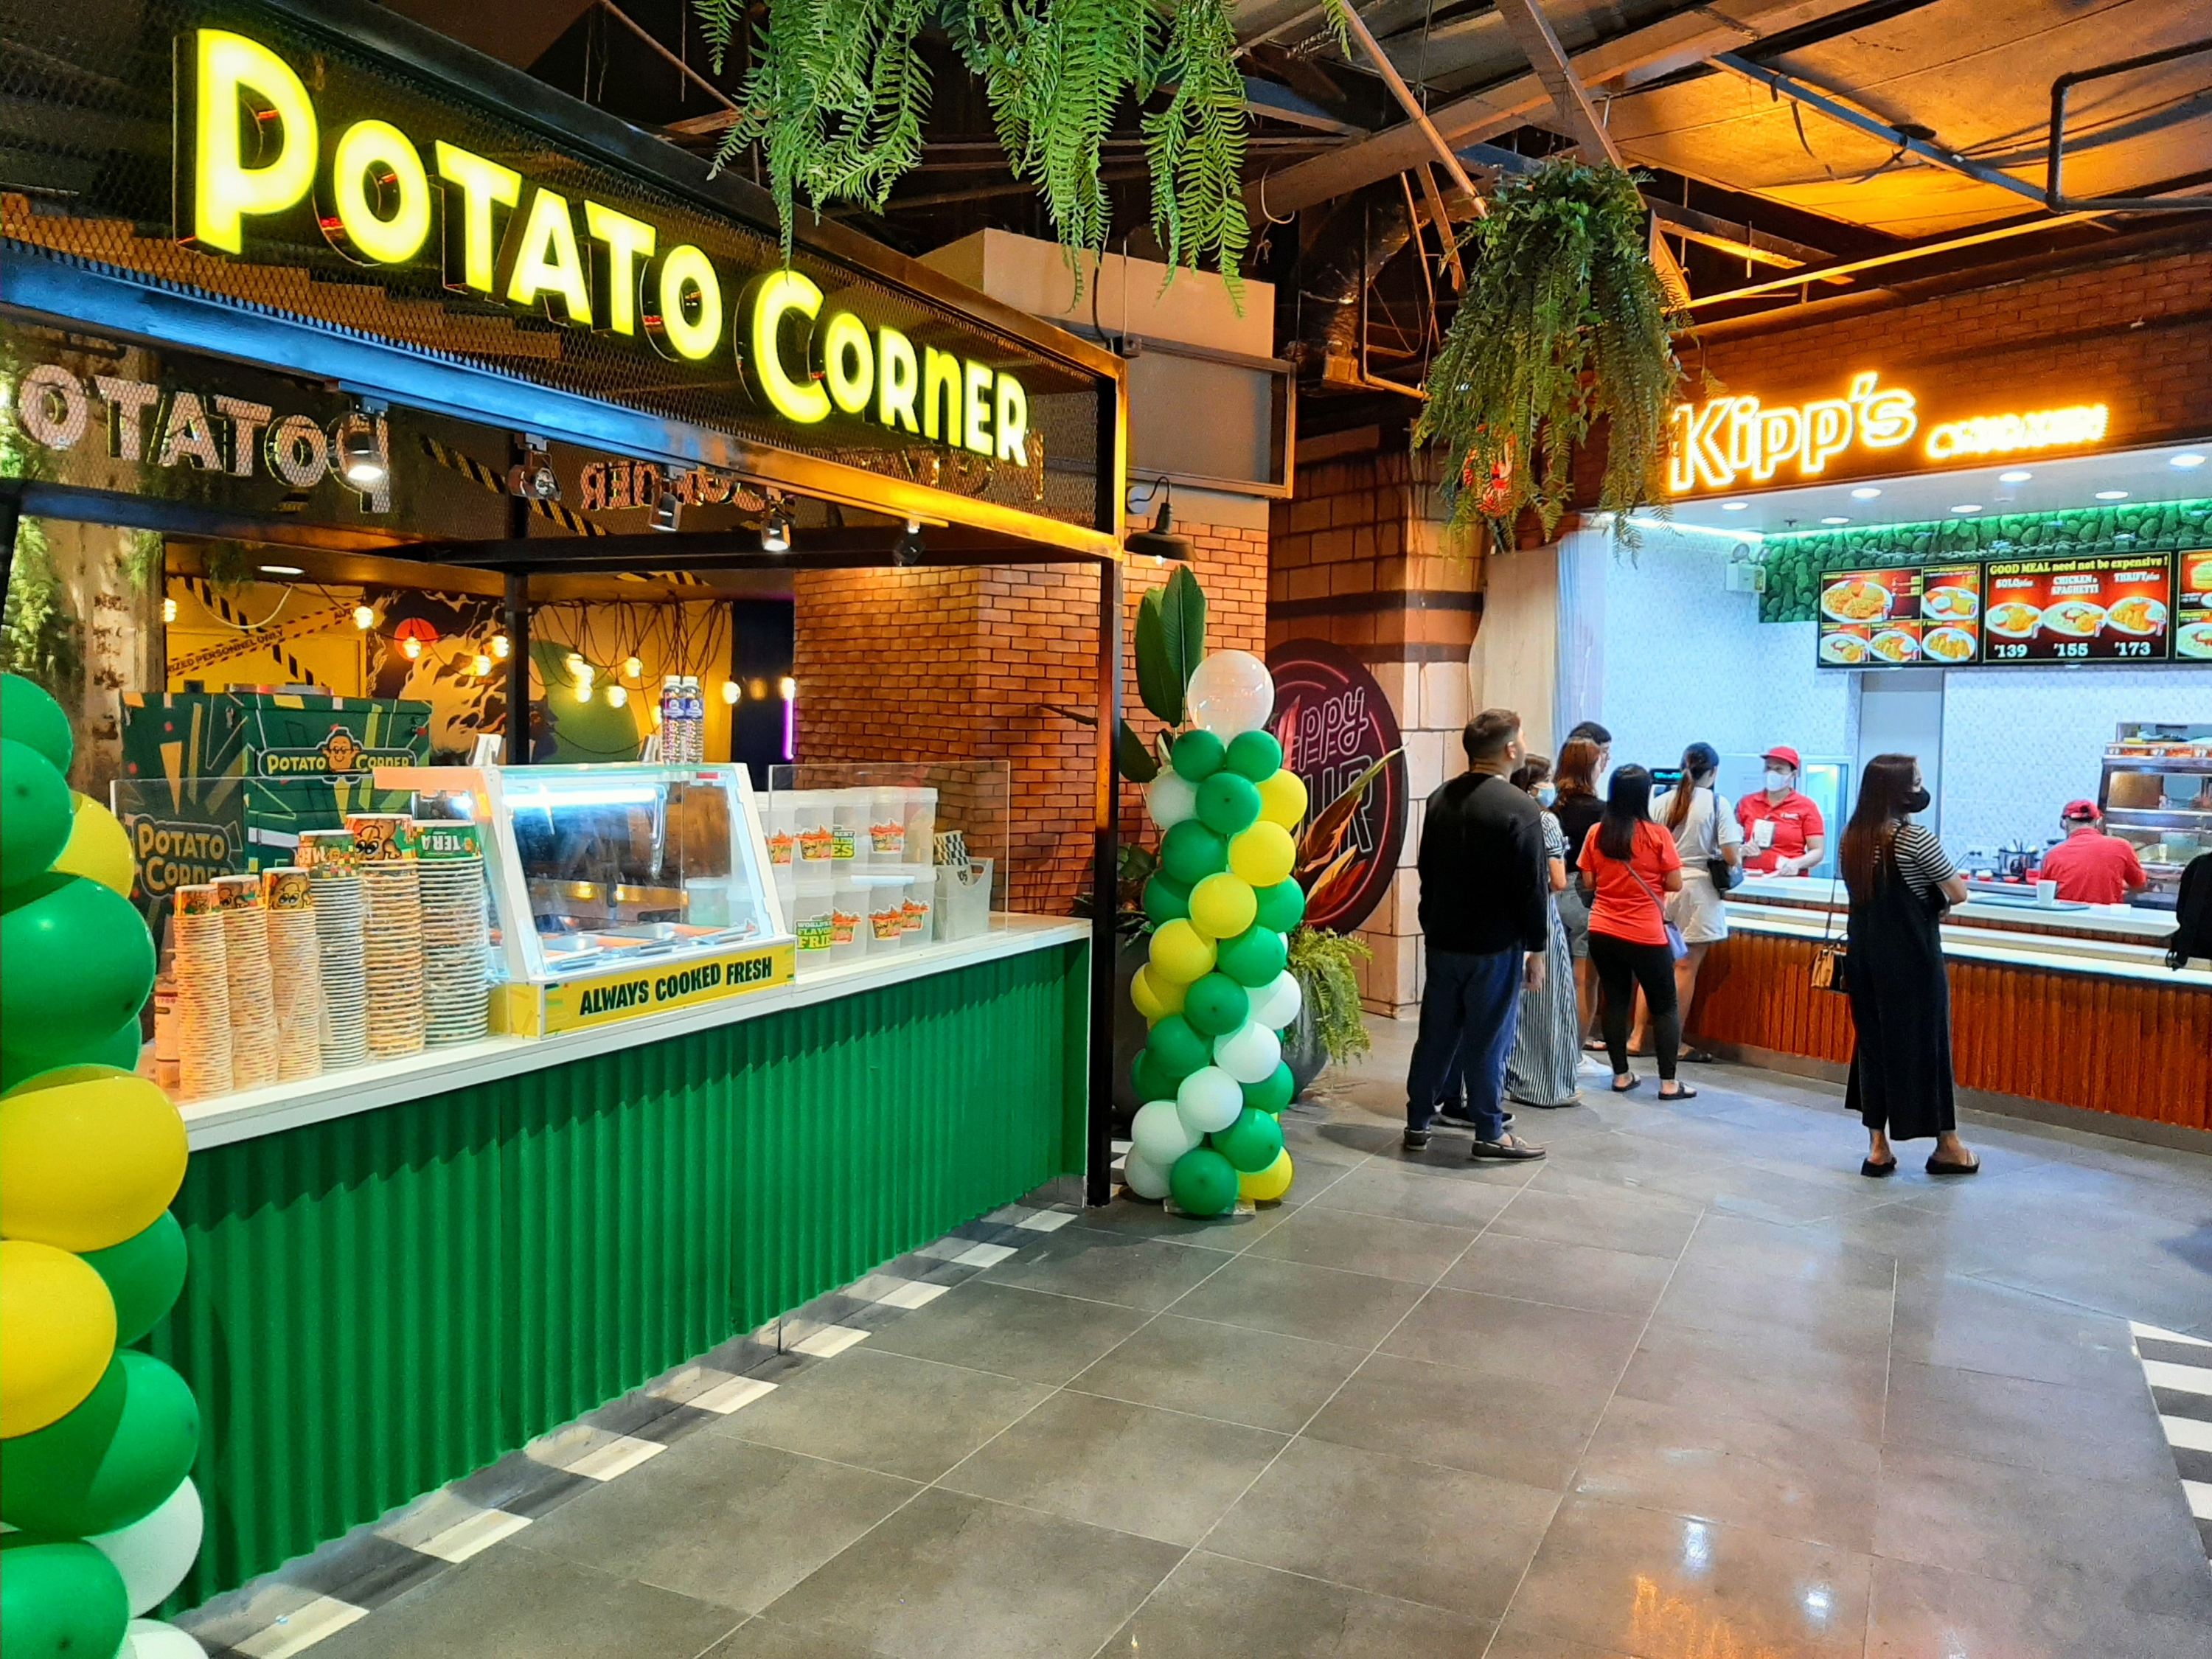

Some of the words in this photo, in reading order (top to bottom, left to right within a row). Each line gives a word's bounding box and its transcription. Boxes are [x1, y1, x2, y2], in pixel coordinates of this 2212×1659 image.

[195, 27, 723, 361] POTATO
[753, 270, 1029, 468] CORNER
[1669, 371, 1919, 492] Kipp's
[1990, 563, 2020, 575] GOOD
[2021, 562, 2051, 574] MEAL
[2052, 560, 2076, 572] need
[2078, 560, 2096, 571] not
[2097, 559, 2110, 569] be
[2111, 556, 2163, 570] expensive
[266, 754, 327, 775] POTATO
[137, 823, 225, 860] POTATO
[420, 834, 462, 851] TERA
[580, 980, 649, 1016] ALWAYS
[655, 963, 721, 1001] COOKED
[726, 956, 773, 986] FRESH
